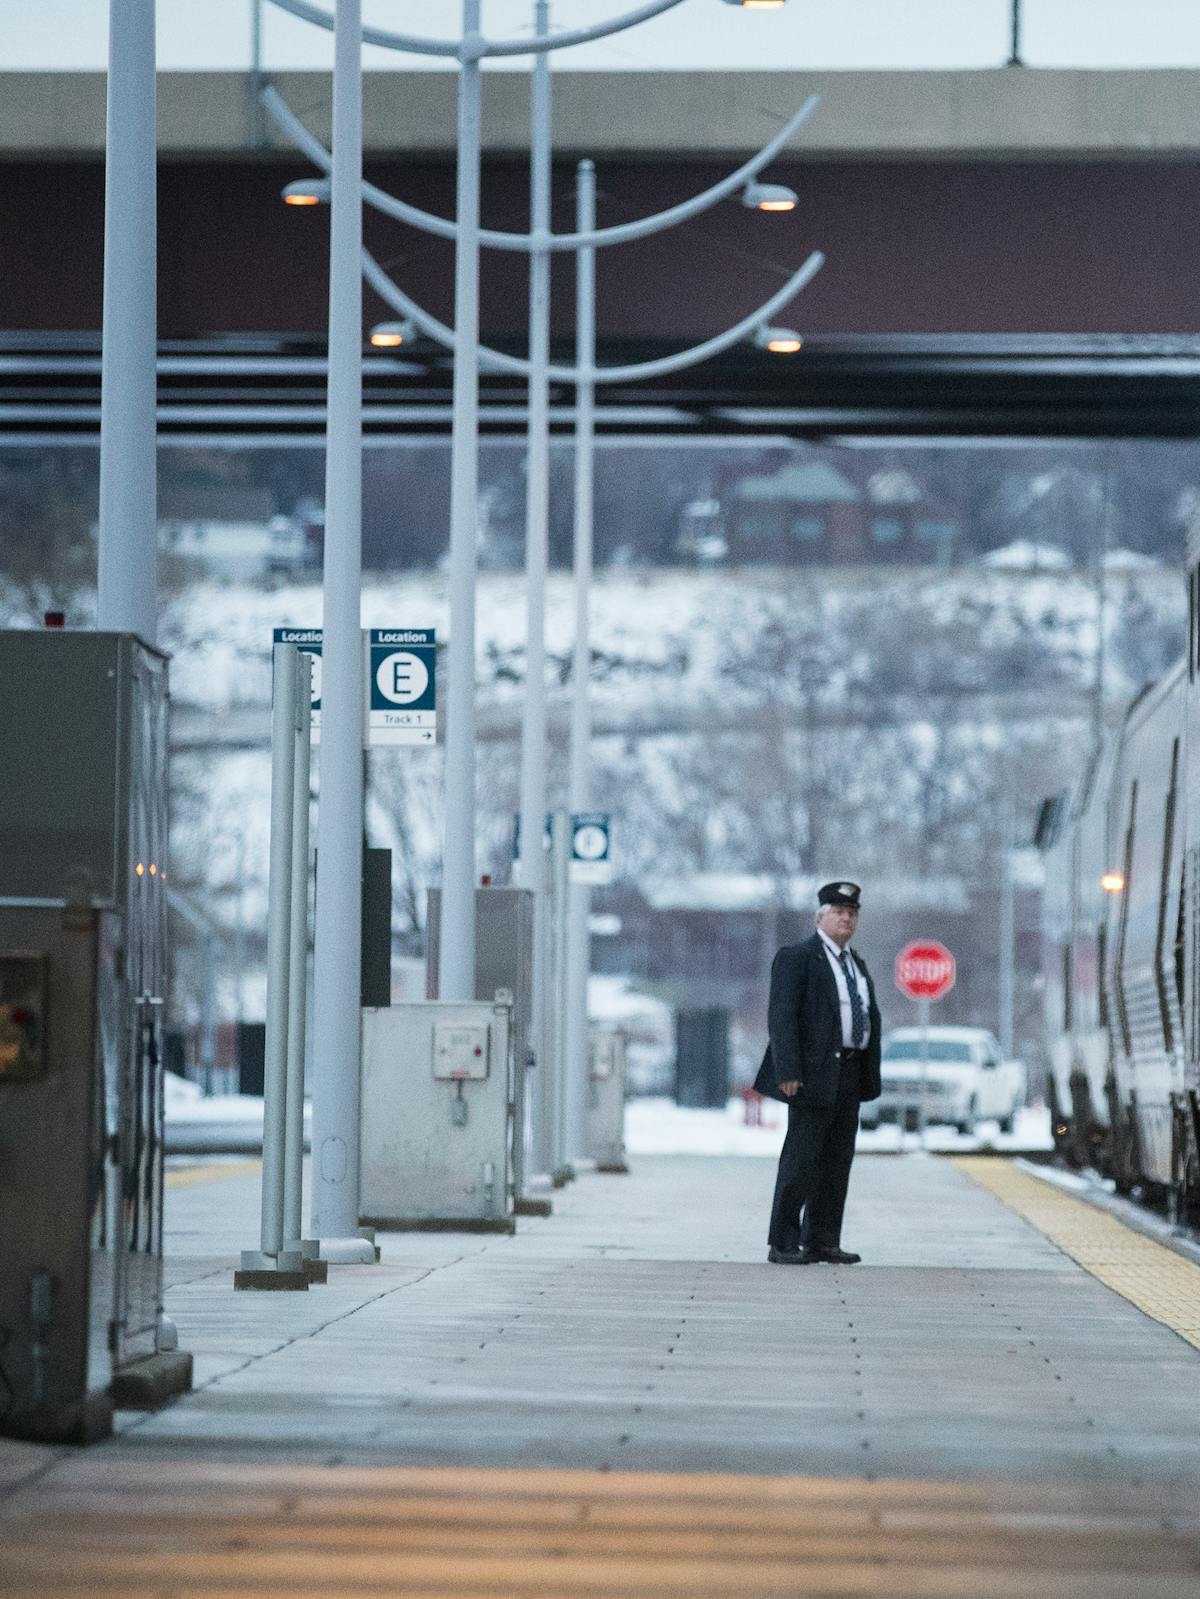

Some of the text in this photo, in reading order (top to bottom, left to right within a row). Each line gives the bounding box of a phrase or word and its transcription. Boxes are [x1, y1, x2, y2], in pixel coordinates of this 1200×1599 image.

[281, 631, 323, 642] Locatio
[378, 631, 427, 643] Location
[393, 661, 412, 694] E
[384, 714, 422, 724] Track 1
[902, 960, 952, 981] STOP
